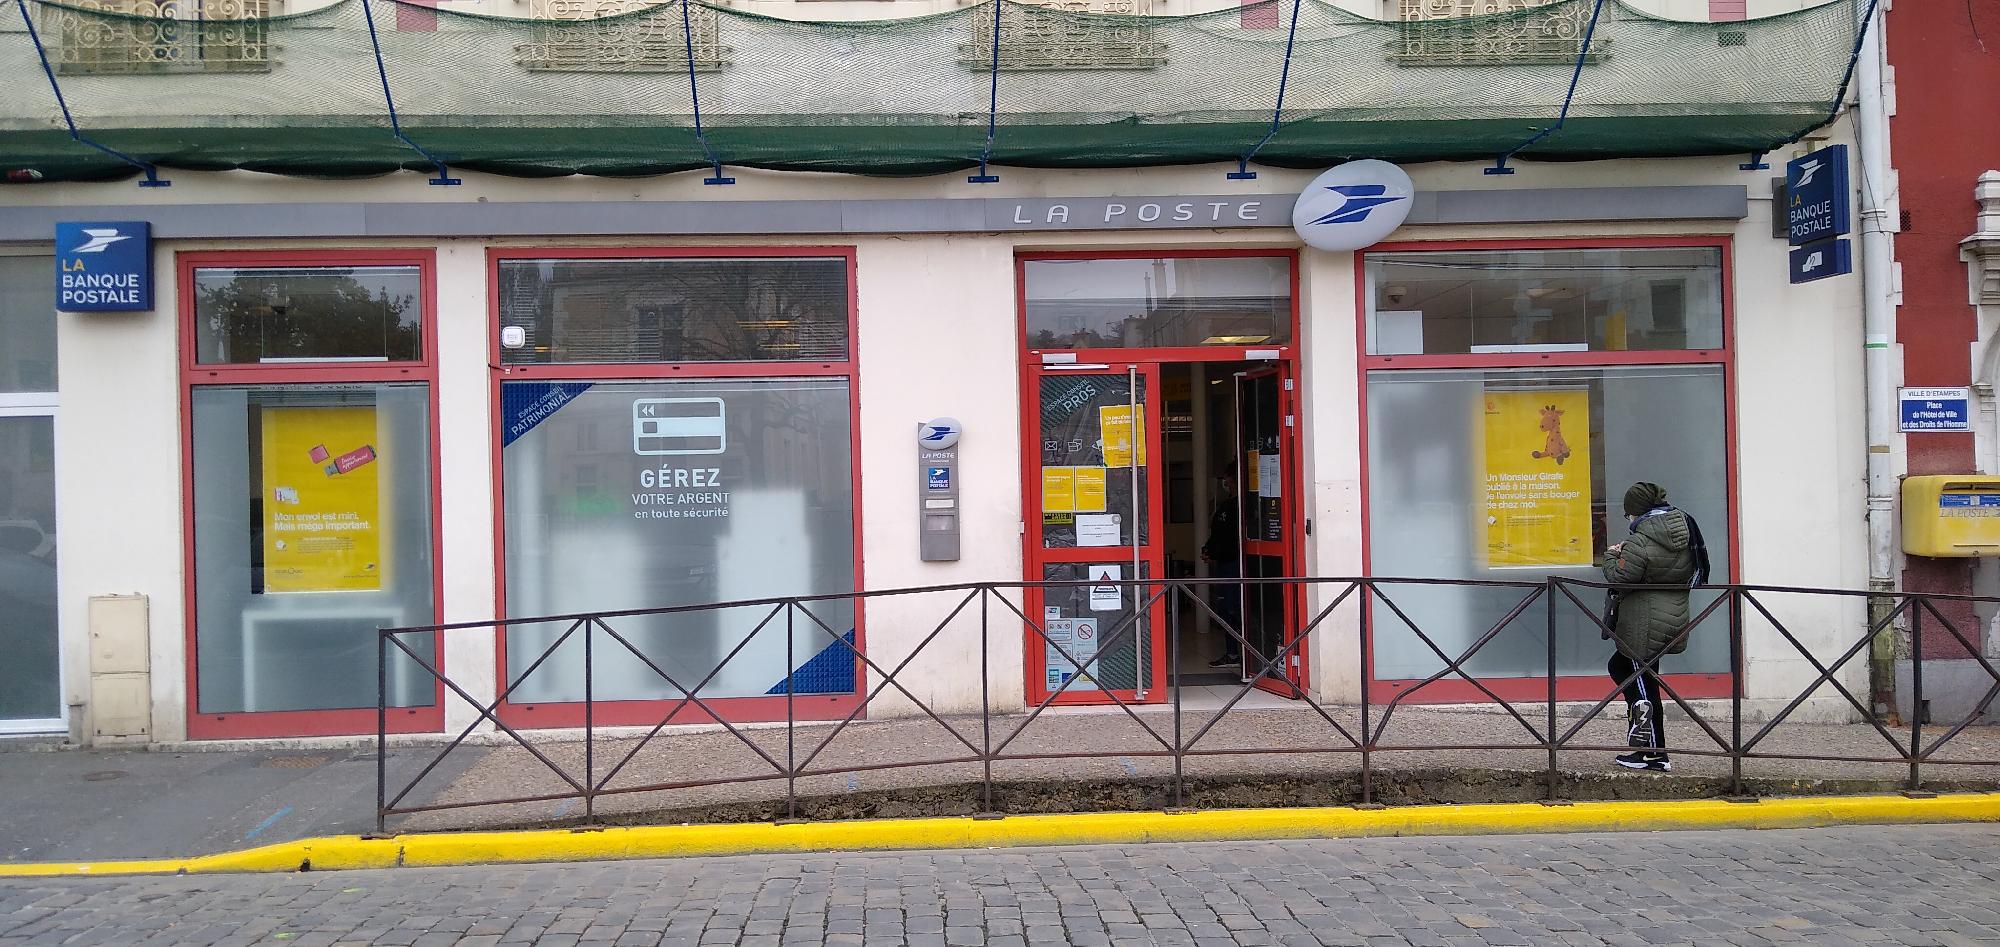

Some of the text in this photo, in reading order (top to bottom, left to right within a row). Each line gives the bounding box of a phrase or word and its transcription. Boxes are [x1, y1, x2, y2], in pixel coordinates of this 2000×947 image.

[1790, 194, 1802, 208] LA
[1013, 201, 1262, 224] LA POSTE
[1790, 200, 1831, 223] BANQUE
[1791, 216, 1832, 239] POSTALE
[62, 258, 85, 272] LA
[62, 274, 140, 289] BANQUE
[62, 290, 140, 304] POSTALE
[1047, 379, 1090, 411] ESPACE CONSEIL
[1063, 385, 1096, 413] PROS
[519, 386, 564, 419] ESPACE CONSEIL
[511, 391, 572, 435] PATRIMONIAL
[1945, 410, 1958, 418] Ville
[1920, 420, 1936, 428] Droits
[640, 463, 720, 488] GÉREZ
[1486, 473, 1498, 482] Un
[1499, 472, 1538, 481] Monsieur
[631, 492, 731, 505] VOTRE ARGENT
[1528, 492, 1549, 500] sans
[1549, 491, 1580, 500] bouger
[634, 505, 729, 519] en toute sécurité
[1498, 501, 1519, 509] chez
[274, 512, 294, 521] Mon
[296, 512, 321, 521] envoi
[322, 512, 337, 520] est
[1957, 508, 1990, 518] POSTE
